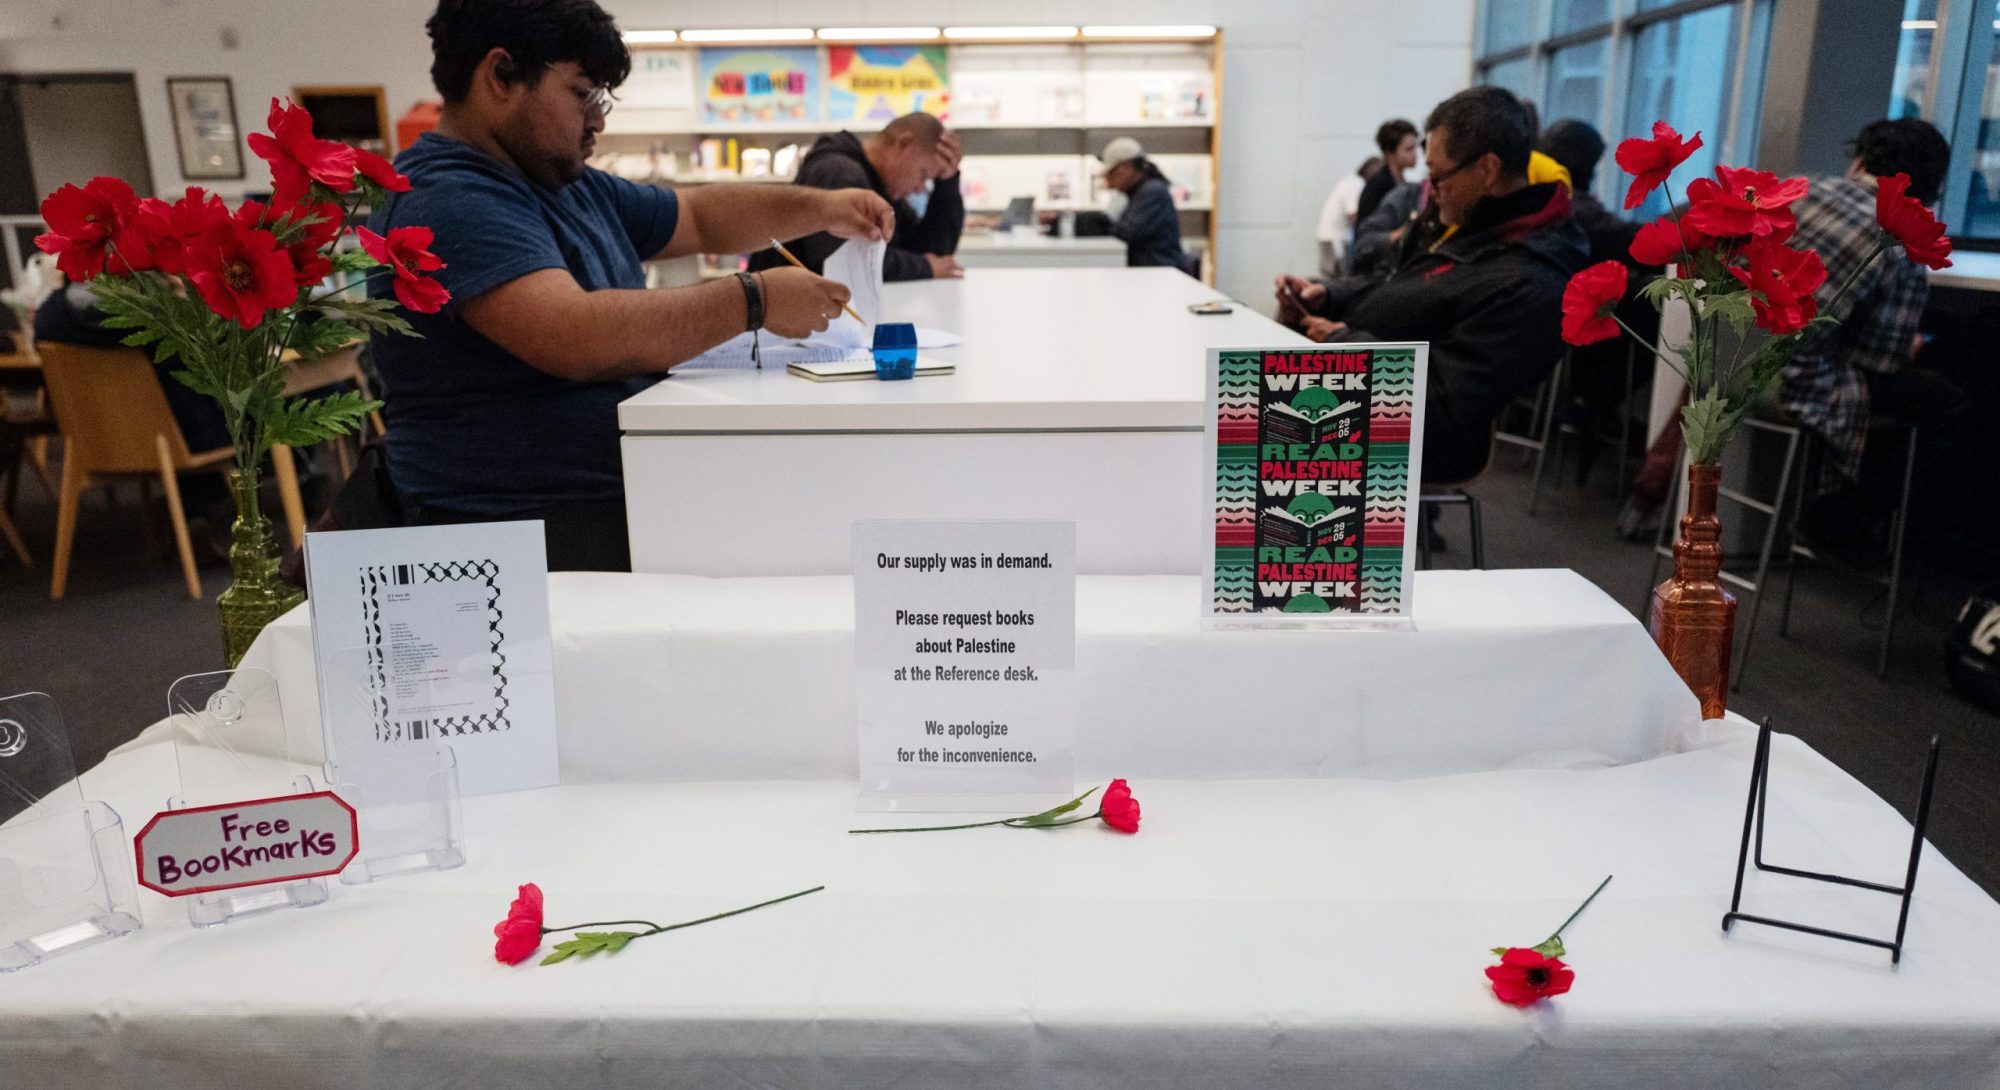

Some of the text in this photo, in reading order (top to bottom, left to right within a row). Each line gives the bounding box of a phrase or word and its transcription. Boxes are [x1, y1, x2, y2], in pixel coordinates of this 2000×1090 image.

[1264, 353, 1368, 374] PALESTINE
[1264, 373, 1367, 392] WEEK
[1338, 418, 1351, 429] 29
[1338, 427, 1350, 438] 05
[1261, 443, 1364, 461] READ
[1261, 460, 1363, 479] PALESTINE
[1260, 480, 1362, 497] WEEK
[1333, 522, 1345, 533] 29
[1333, 531, 1344, 542] 05
[877, 553, 1052, 572] Our supply was in demand.
[1258, 546, 1359, 563] READ
[1258, 563, 1357, 581] PALESTINE
[1257, 581, 1357, 598] WEEK
[896, 610, 1035, 629] Please request books
[916, 638, 1016, 653] about Palestine
[894, 666, 1039, 681] at the Reference desk.
[925, 720, 1009, 739] We apologize
[897, 747, 1037, 763] for the inconvenience.
[220, 813, 291, 842] Free
